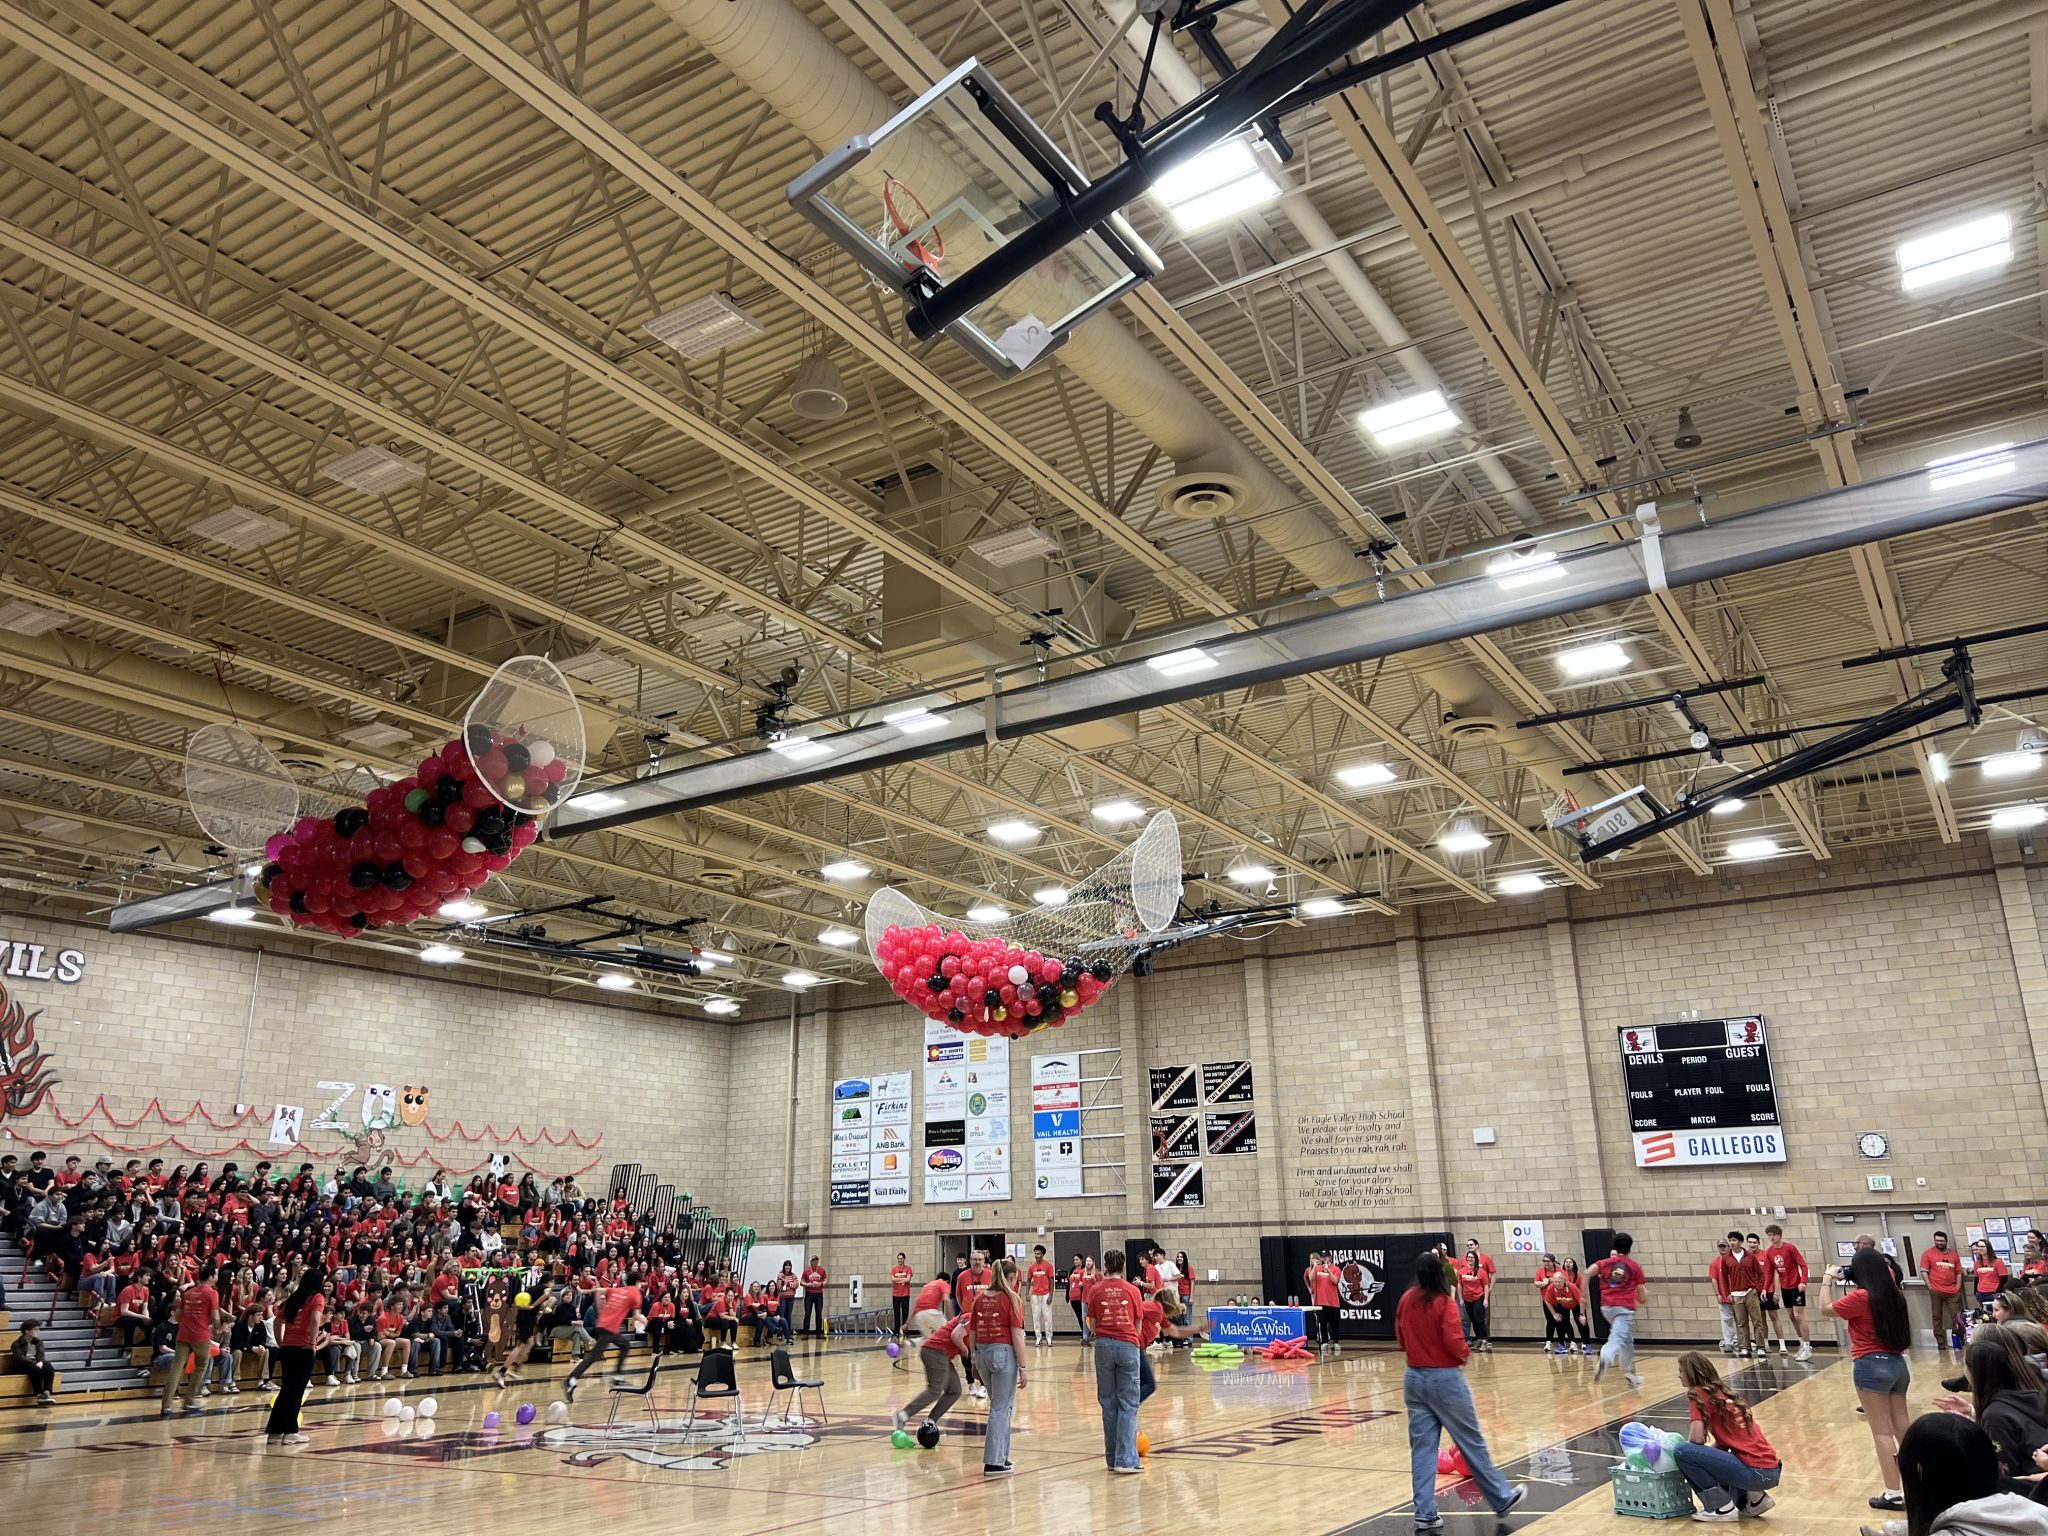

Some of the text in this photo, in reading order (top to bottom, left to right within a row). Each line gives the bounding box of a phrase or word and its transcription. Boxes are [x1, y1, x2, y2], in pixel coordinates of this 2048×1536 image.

[1629, 1046, 1760, 1065] DEVILS GUEST
[1682, 1055, 1708, 1065] PERIOD
[1162, 1075, 1185, 1100] CHAMPIONS
[1630, 1083, 1770, 1099] FOULS PLAYER FOUL FOULS
[1173, 1097, 1198, 1105] BASEBALL
[877, 1101, 908, 1115] Firkins
[1312, 1114, 1332, 1125] Eagle
[1333, 1113, 1356, 1124] Valley
[1359, 1111, 1377, 1122] High
[1379, 1110, 1405, 1120] School
[1634, 1112, 1775, 1127] SCORE MATCH SCORE
[1053, 1128, 1079, 1136] HEALTH
[1167, 1124, 1188, 1146] CHAMPIONS
[1298, 1126, 1310, 1135] We
[1312, 1124, 1336, 1136] pledge
[1355, 1122, 1382, 1133] loyalty
[1385, 1121, 1401, 1130] and
[890, 1141, 905, 1149] Bank
[1301, 1136, 1313, 1145] We
[1315, 1135, 1333, 1144] shall
[1335, 1134, 1362, 1145] forever
[1365, 1134, 1382, 1143] sing
[1688, 1134, 1776, 1157] GALLEGOS
[1179, 1143, 1193, 1151] BOYS
[1300, 1146, 1329, 1156] Praises
[1330, 1146, 1338, 1154] to
[1340, 1146, 1355, 1155] you
[1392, 1141, 1407, 1151] rah
[832, 1161, 868, 1169] COLLETT
[1297, 1163, 1413, 1176] Firm and undaunted we shall
[1163, 1167, 1194, 1204] STATE CHAMPIONS
[1314, 1177, 1337, 1187] Strive
[1338, 1177, 1350, 1187] for
[1372, 1175, 1393, 1185] glory
[1872, 1177, 1888, 1189] EXIT
[874, 1186, 908, 1197] Vail Daily
[1299, 1185, 1412, 1198] Hail Eagle Valley High School
[1314, 1200, 1329, 1208] Our
[1330, 1199, 1347, 1207] hats
[1348, 1198, 1361, 1208] off
[1363, 1198, 1372, 1206] to
[1505, 1221, 1531, 1237] YOU
[1507, 1241, 1541, 1251] COOL
[1330, 1249, 1384, 1271] AGLE VALLEY
[1340, 1309, 1382, 1320] DEVILS
[1149, 1408, 1403, 1457] DEVILS
